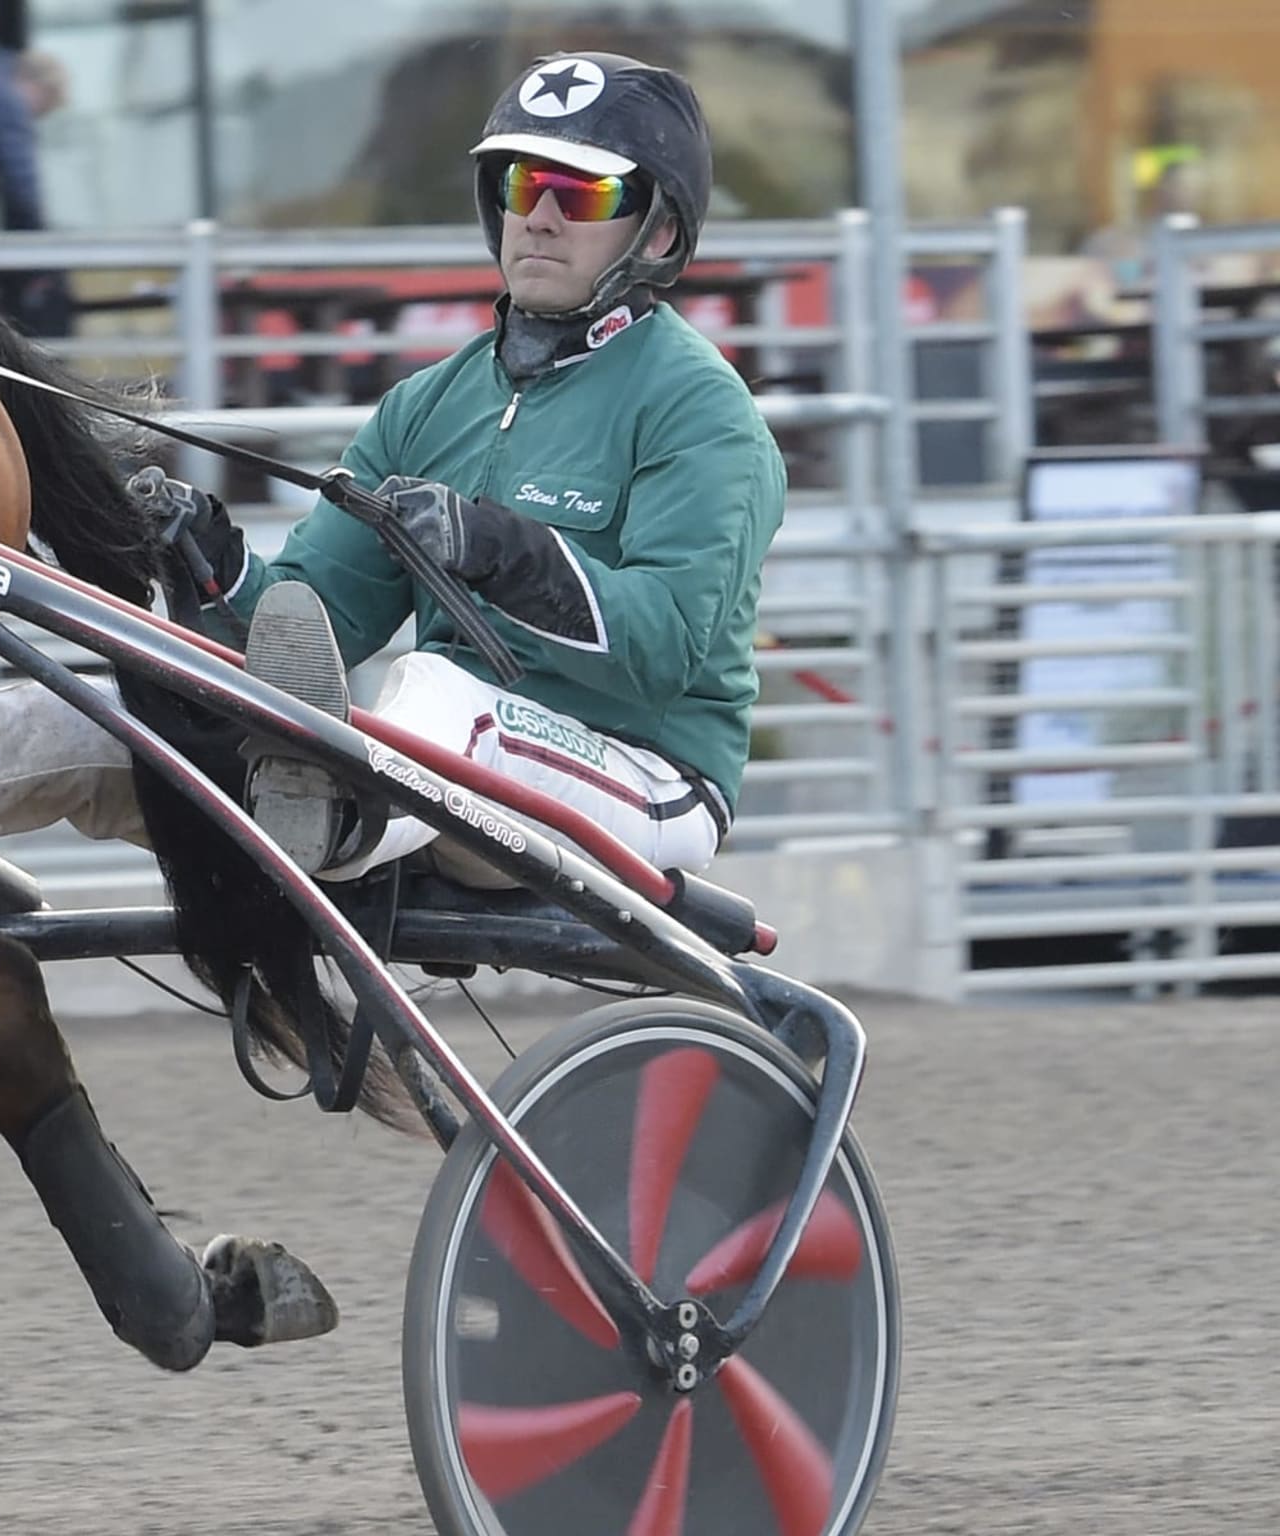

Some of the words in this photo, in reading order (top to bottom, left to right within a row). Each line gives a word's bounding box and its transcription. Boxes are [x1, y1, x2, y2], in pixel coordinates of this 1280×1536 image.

[515, 484, 559, 506] Stens
[563, 490, 603, 514] Trot
[366, 738, 442, 803] Custom
[444, 784, 527, 853] Chrono
